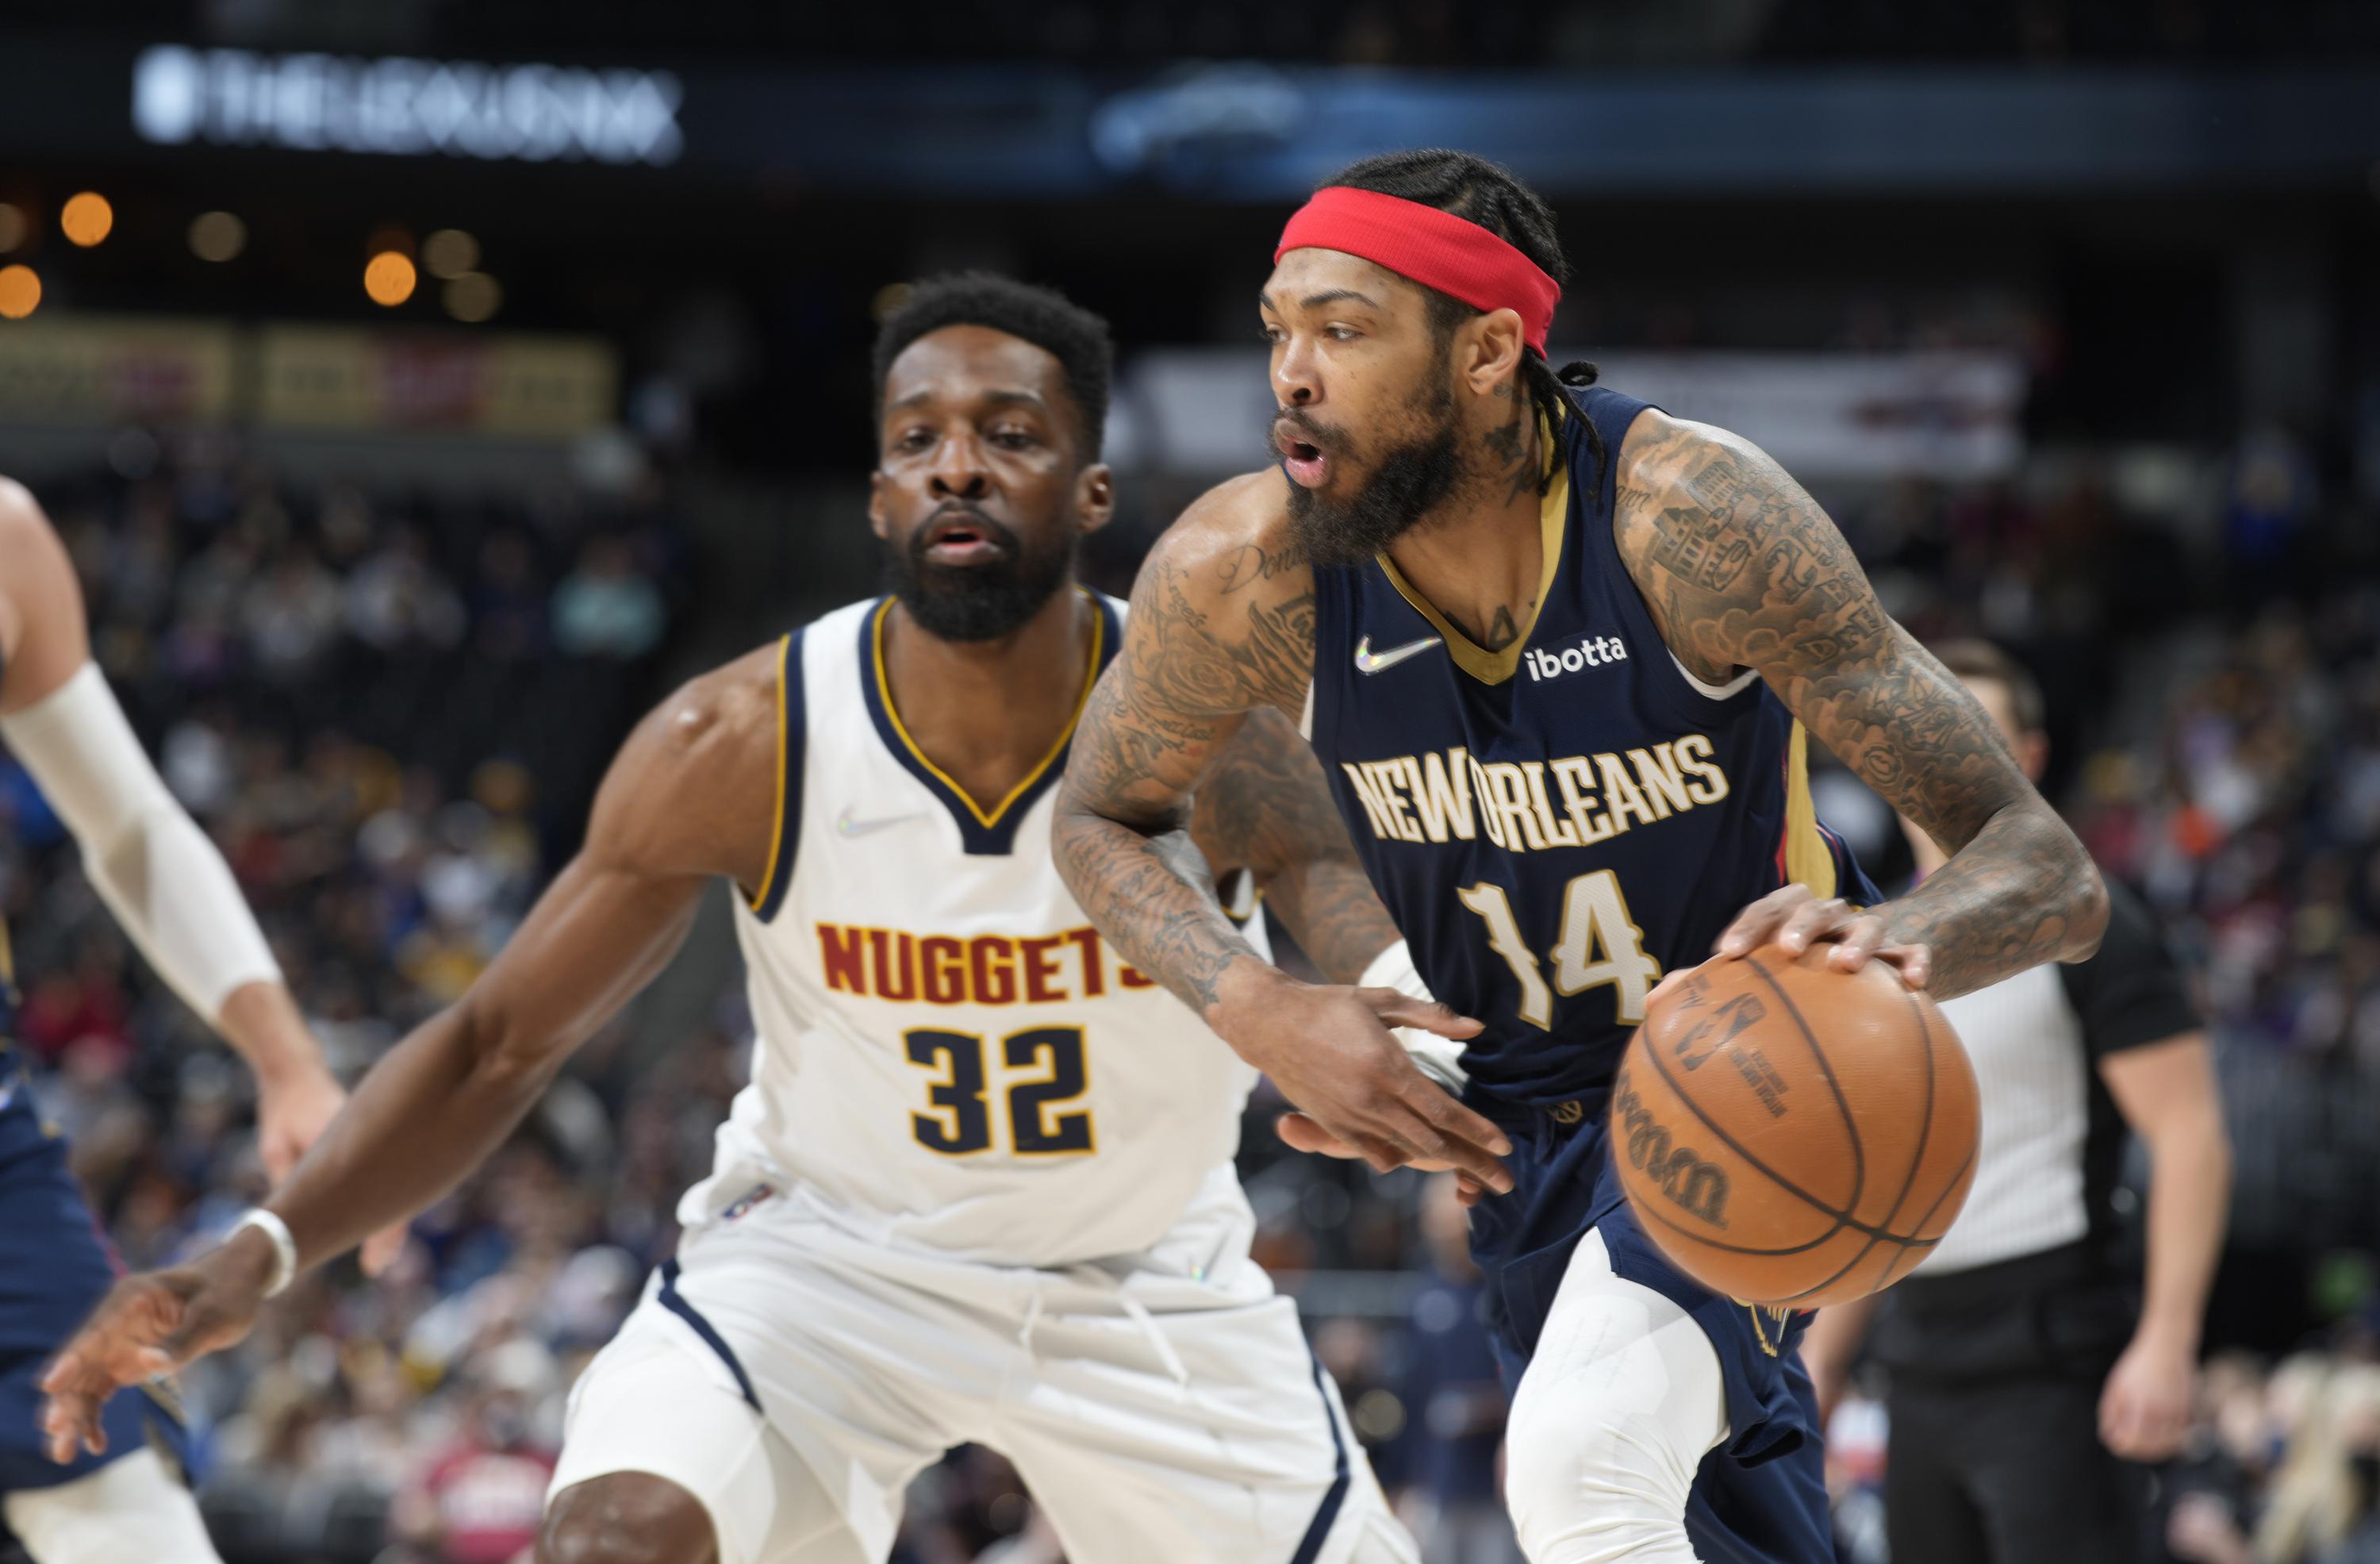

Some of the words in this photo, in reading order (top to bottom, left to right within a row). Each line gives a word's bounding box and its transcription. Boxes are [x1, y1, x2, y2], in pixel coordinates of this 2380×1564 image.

[1524, 634, 1629, 683] ibotta
[1342, 746, 1477, 844] NEW
[1467, 734, 1730, 854] ORLEANS
[1456, 867, 1664, 1032] 14
[901, 1024, 1097, 1158] 32
